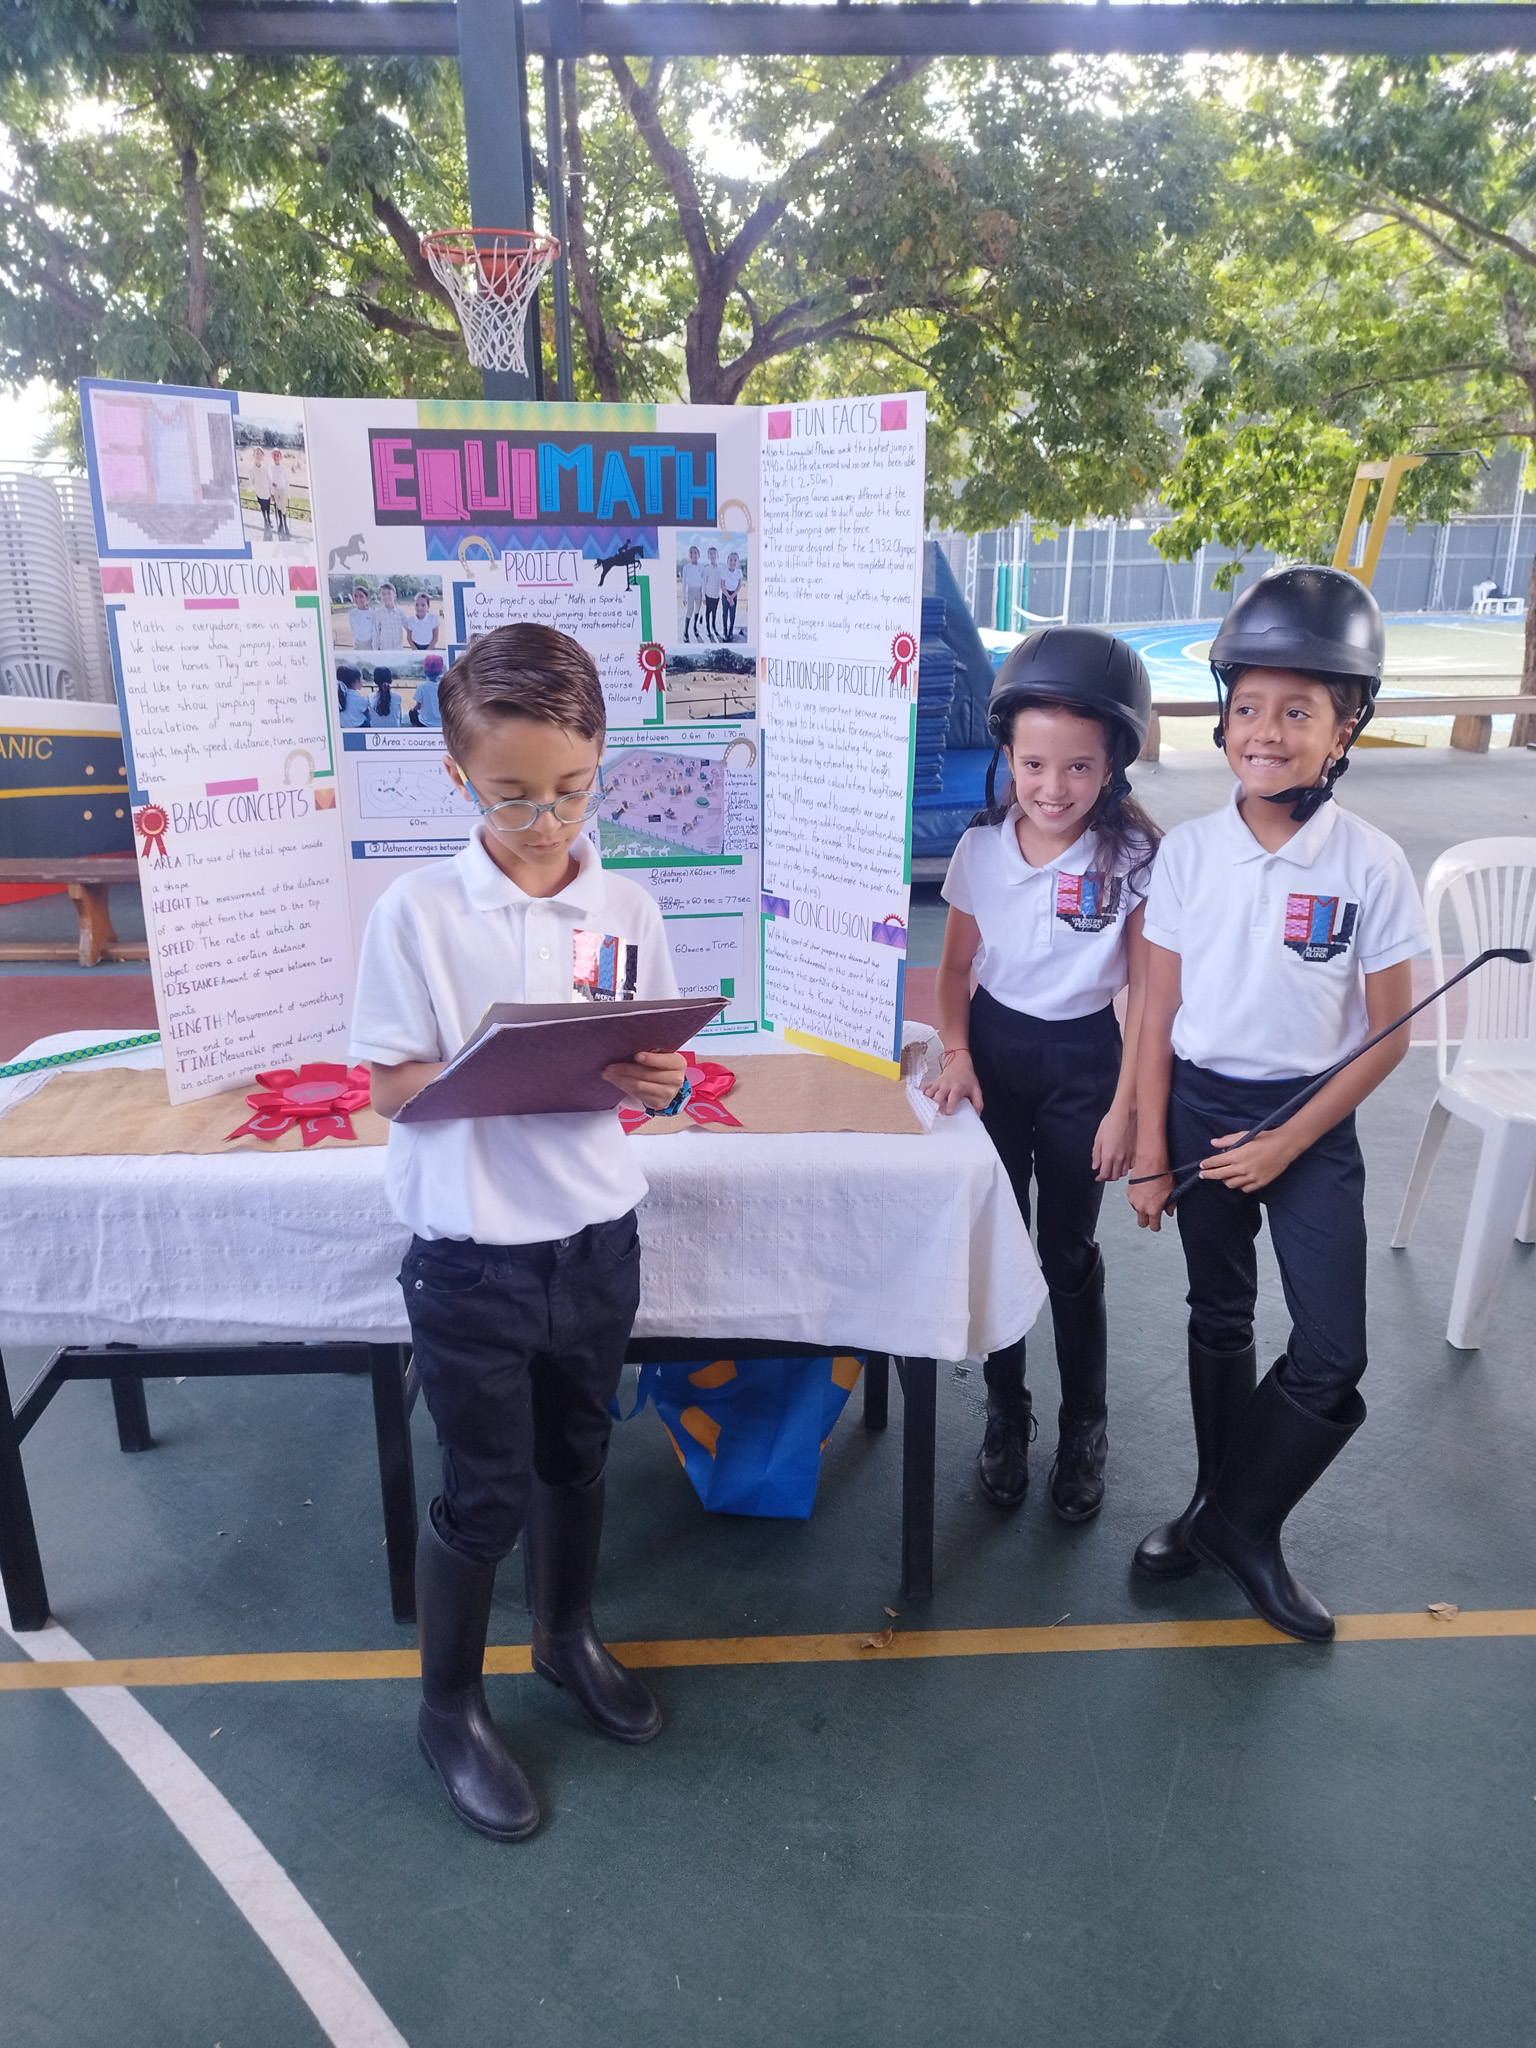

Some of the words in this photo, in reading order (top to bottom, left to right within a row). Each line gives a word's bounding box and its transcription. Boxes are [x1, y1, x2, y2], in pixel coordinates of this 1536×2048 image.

[796, 407, 825, 437] FUN
[833, 402, 877, 435] FACTS
[372, 439, 715, 520] EQUIMATH
[141, 561, 284, 597] INTRODUCTION
[504, 552, 578, 582] PROJECT
[466, 608, 478, 618] We
[483, 609, 504, 618] chose
[507, 608, 528, 617] horse
[589, 609, 622, 617] because
[475, 593, 493, 605] Our
[500, 597, 526, 612] project
[538, 596, 559, 605] about
[132, 620, 165, 633] Math
[270, 621, 279, 629] in
[470, 622, 482, 630] love
[559, 623, 578, 634] many
[582, 619, 634, 629] mathematical
[130, 640, 143, 653] We
[151, 641, 174, 652] chose
[181, 642, 199, 650] horse
[208, 641, 228, 650] show
[278, 638, 307, 648] because
[600, 654, 610, 662] lot
[614, 653, 625, 662] of
[127, 666, 141, 674] we
[153, 660, 170, 672] love
[217, 655, 239, 679] They
[245, 660, 259, 668] are
[768, 658, 834, 691] RELATIONSHIP
[128, 684, 147, 694] and
[153, 680, 171, 692] like
[177, 680, 187, 691] to
[191, 682, 209, 691] run
[215, 677, 232, 689] and
[240, 680, 262, 694] jump
[140, 700, 170, 715] Horse
[178, 699, 208, 710] show
[216, 699, 255, 719] jumping
[267, 696, 297, 714] requires
[303, 693, 317, 703] the
[608, 695, 642, 704] following
[135, 720, 199, 736] calculation
[209, 719, 219, 729] of
[230, 721, 252, 736] many
[609, 736, 634, 745] ranges
[708, 731, 715, 739] to
[298, 735, 326, 750] among
[172, 799, 223, 834] BASIC
[227, 788, 308, 824] CONCEPTS
[186, 853, 203, 866] The
[207, 855, 221, 863] size
[226, 850, 234, 861] of
[239, 847, 251, 859] the
[254, 846, 274, 857] total
[302, 840, 323, 849] inside
[152, 885, 159, 893] a
[196, 896, 209, 907] The
[216, 887, 266, 904] measurement
[297, 877, 330, 889] distance
[191, 919, 213, 934] object
[218, 914, 236, 923] from
[260, 908, 276, 916] base
[281, 904, 287, 912] to
[793, 900, 869, 942] CONCLUSION
[201, 937, 221, 949] The
[226, 934, 246, 943] rate
[251, 930, 260, 939] at
[266, 923, 294, 937] which
[712, 941, 737, 949] Time
[164, 964, 189, 982] object
[196, 960, 221, 970] covers
[238, 950, 268, 962] certain
[221, 973, 248, 985] Amount
[264, 967, 284, 979] space
[288, 961, 316, 973] between
[321, 956, 333, 964] two
[227, 1007, 284, 1025] Measurement
[300, 992, 344, 1008] something
[177, 1047, 197, 1058] from
[203, 1040, 219, 1051] end
[220, 1045, 266, 1063] Measurable
[272, 1038, 293, 1053] period
[297, 1032, 323, 1044] during
[326, 1023, 347, 1035] which
[197, 1074, 224, 1087] action
[228, 1070, 237, 1078] or
[240, 1063, 266, 1075] process
